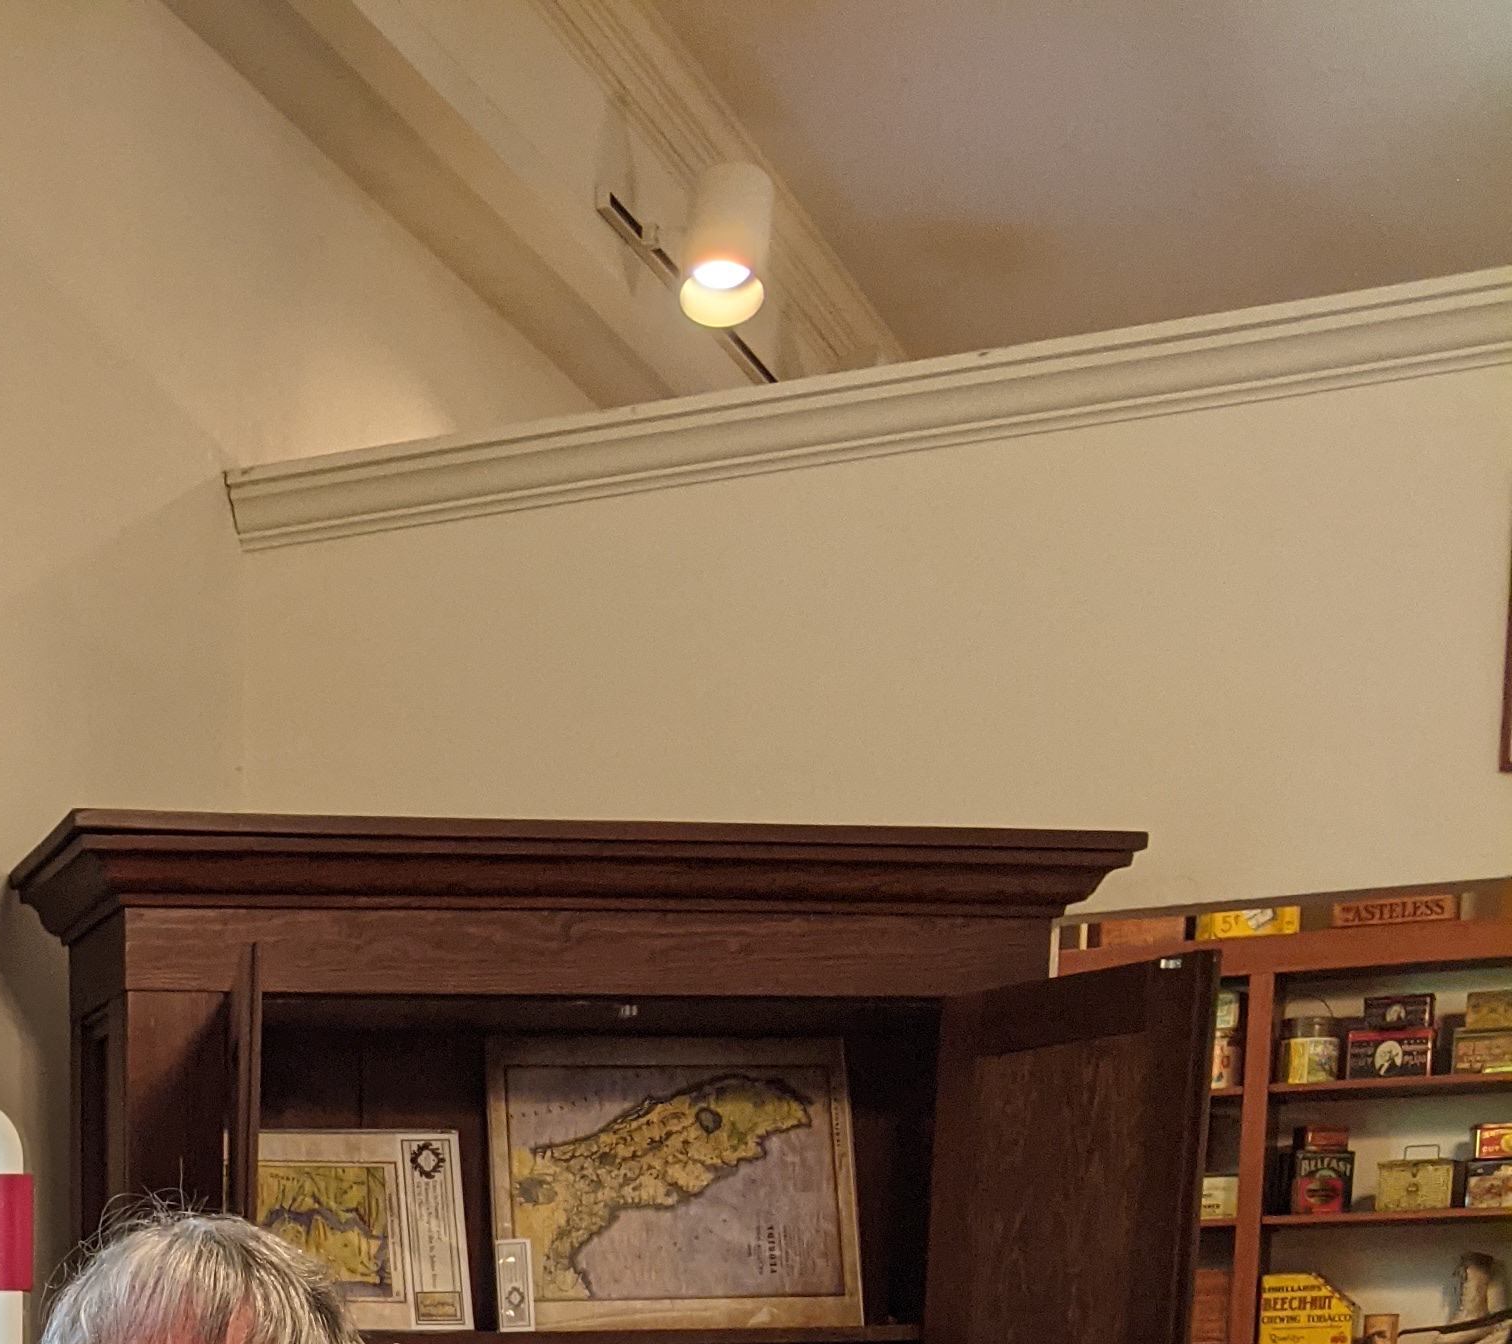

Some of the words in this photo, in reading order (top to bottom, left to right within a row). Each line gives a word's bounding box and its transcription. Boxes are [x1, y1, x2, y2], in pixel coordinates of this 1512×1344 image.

[1300, 1157, 1352, 1177] BELFAST
[767, 1224, 777, 1274] FLORIDA
[1262, 1295, 1334, 1311] BEECH-NUT
[1261, 1315, 1300, 1324] CHEWING
[1307, 1314, 1352, 1323] TOBACCO
